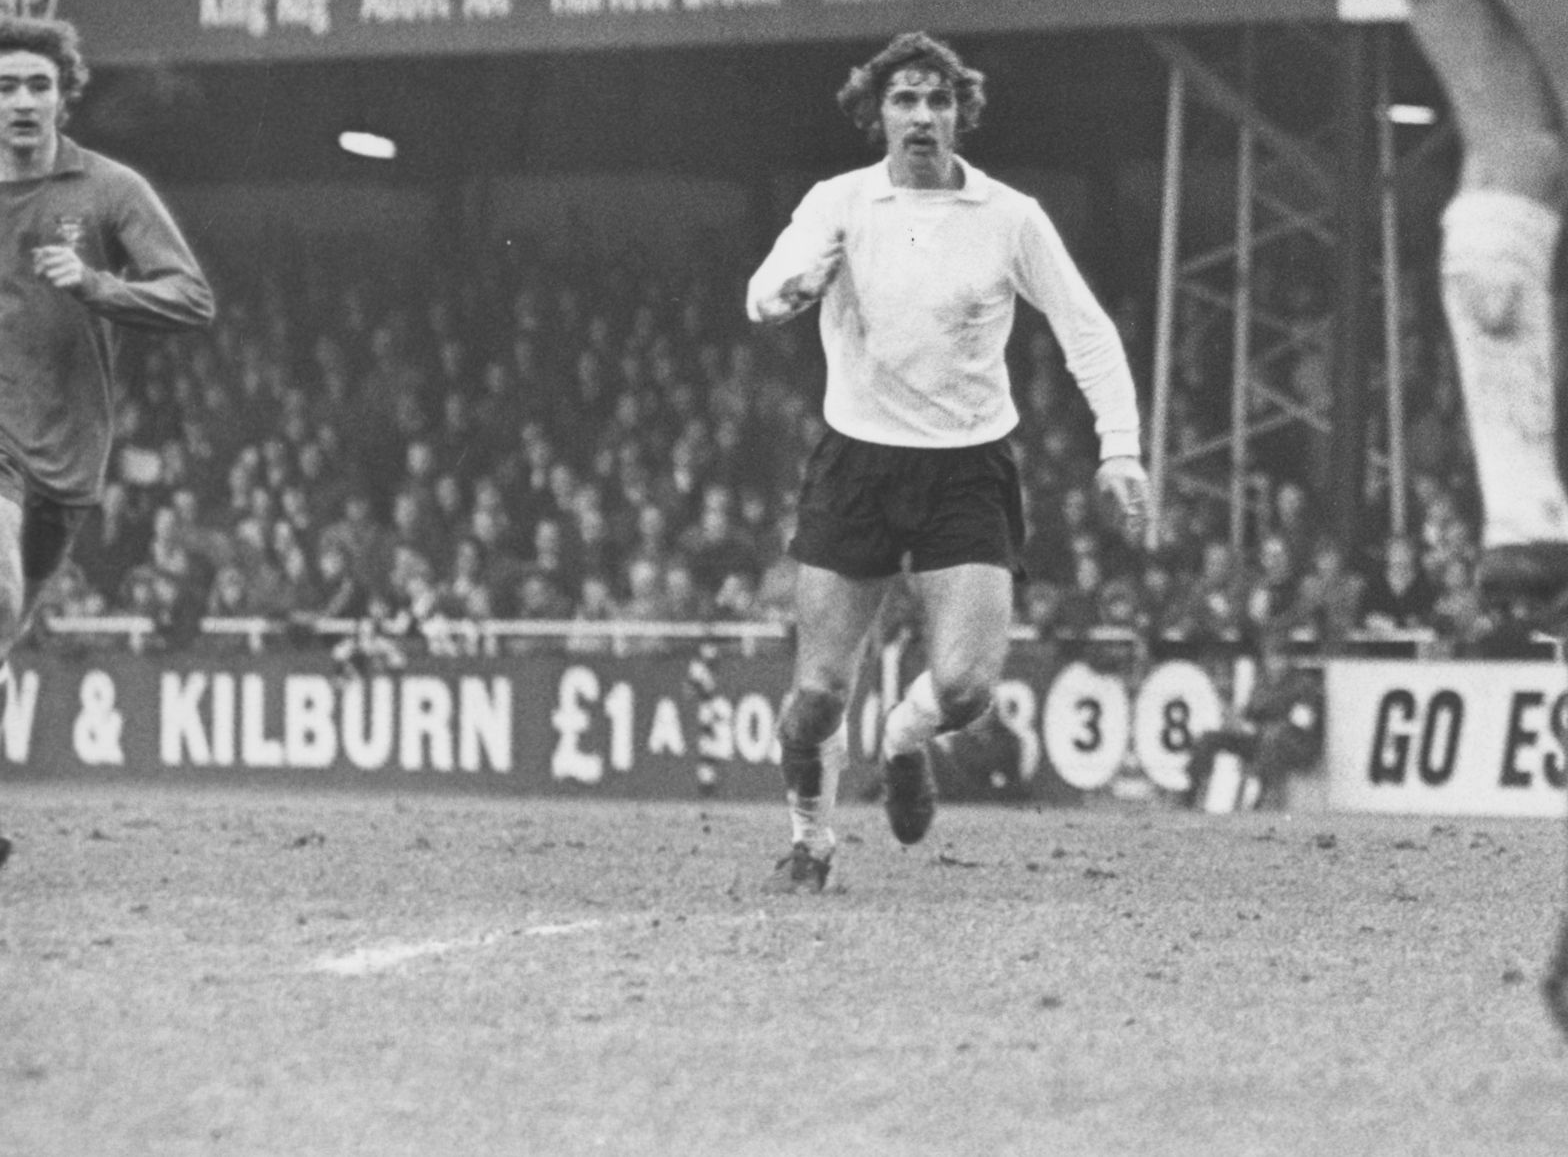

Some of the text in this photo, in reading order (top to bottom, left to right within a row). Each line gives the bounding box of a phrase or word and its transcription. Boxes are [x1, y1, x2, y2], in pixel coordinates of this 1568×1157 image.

[73, 669, 124, 765] &
[160, 672, 513, 772] KILBURN
[551, 666, 633, 782] £1
[648, 698, 686, 755] A
[1368, 688, 1466, 787] GO
